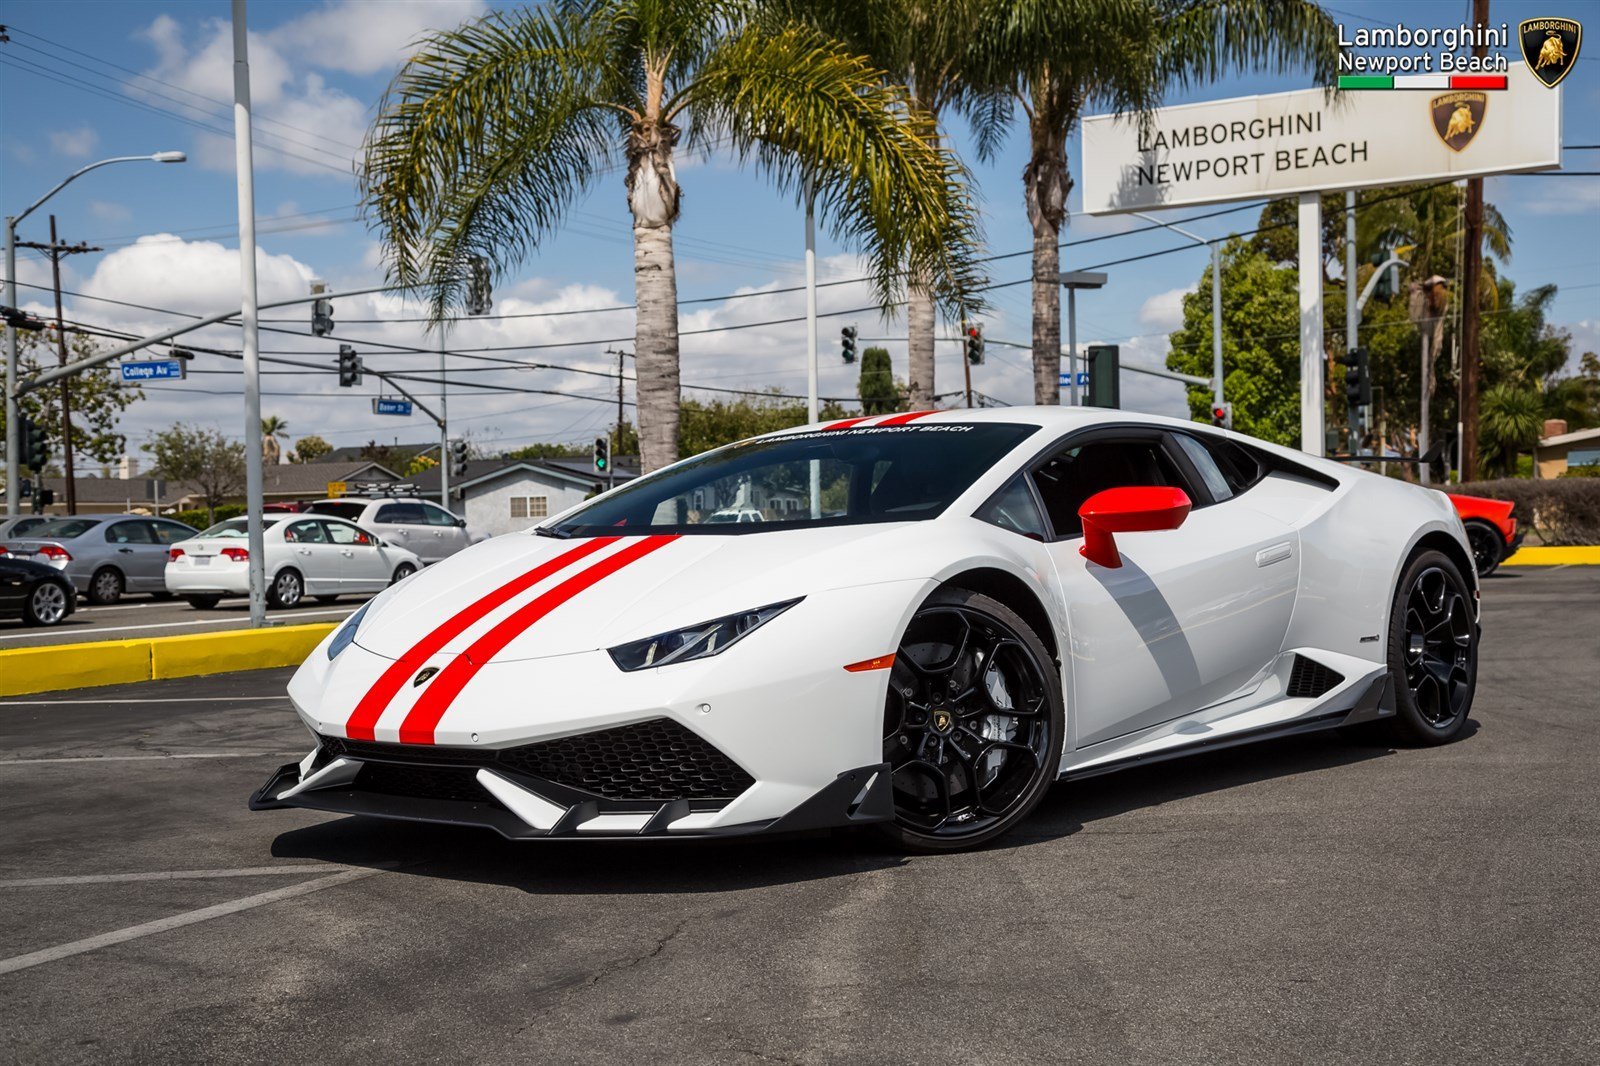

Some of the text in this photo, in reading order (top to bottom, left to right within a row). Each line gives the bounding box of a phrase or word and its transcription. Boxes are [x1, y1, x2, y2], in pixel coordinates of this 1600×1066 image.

[1138, 111, 1321, 153] LAMBORGHINI
[1138, 140, 1368, 186] NEWPORT BEACH
[123, 366, 154, 378] College
[756, 430, 849, 444] LAMBORGHINI
[848, 426, 921, 435] NEWPORT
